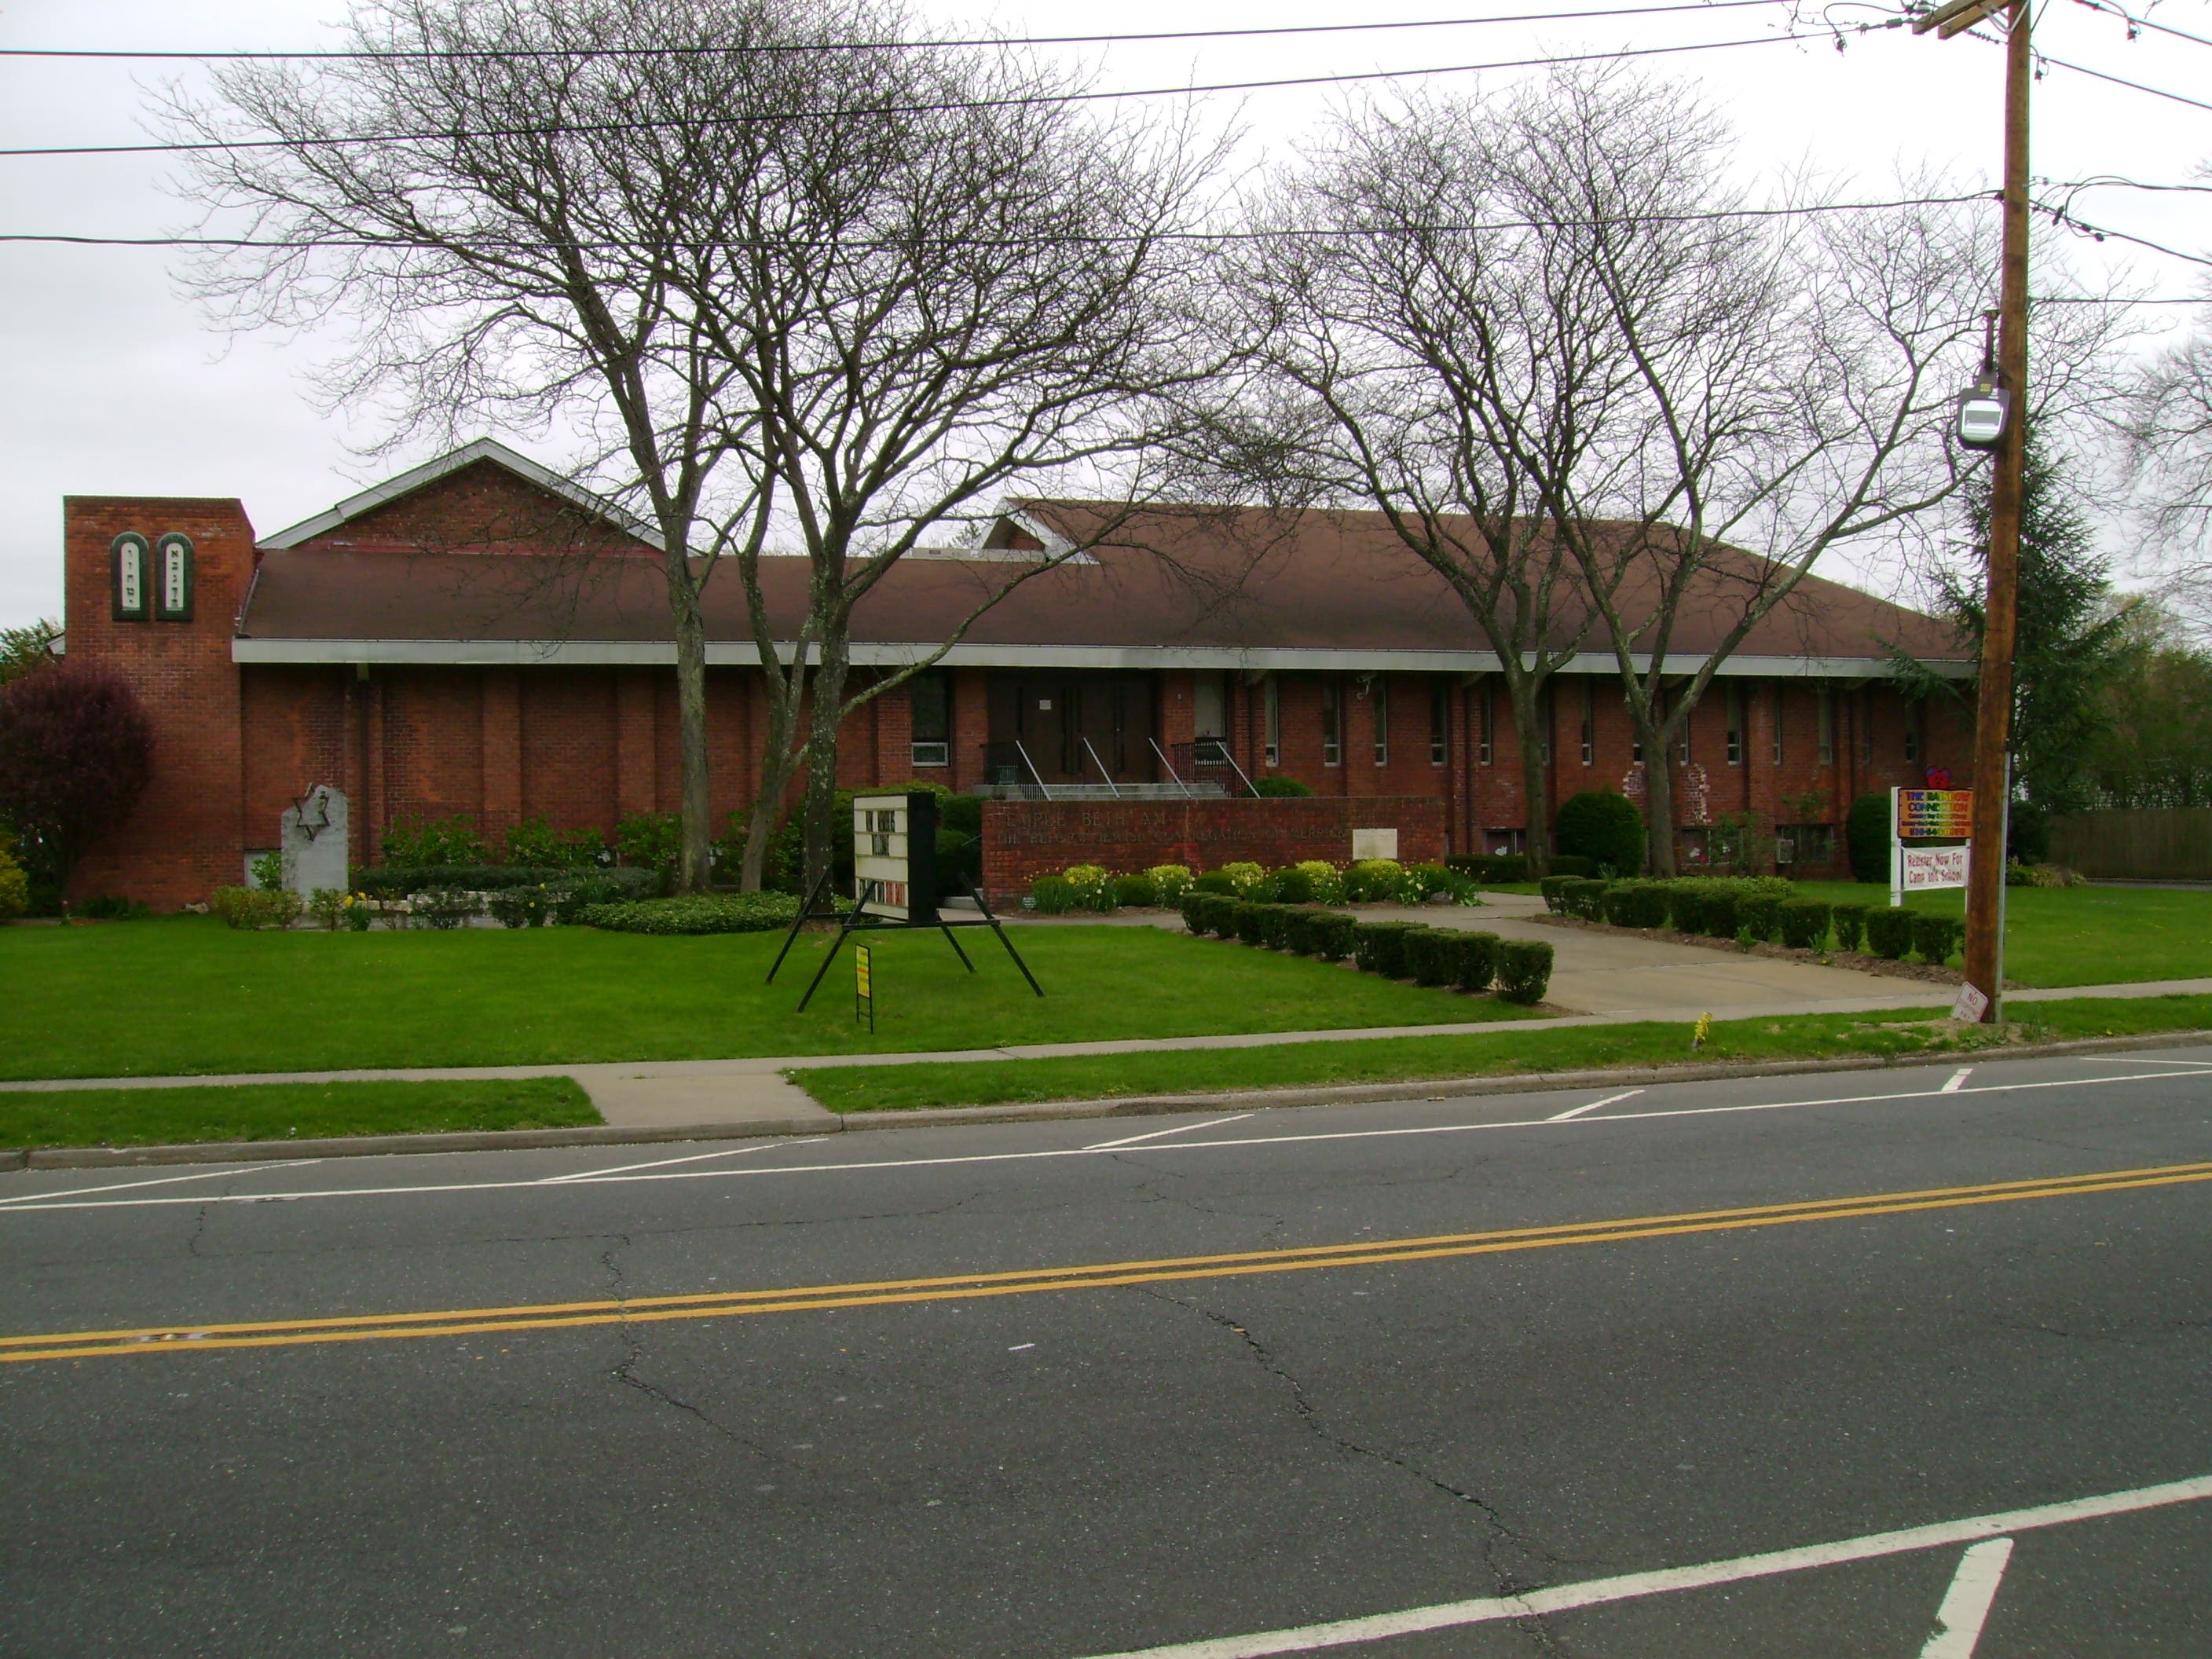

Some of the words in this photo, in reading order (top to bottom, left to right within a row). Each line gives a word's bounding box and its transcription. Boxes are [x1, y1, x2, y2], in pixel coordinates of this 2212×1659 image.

[1906, 792, 1924, 801] THE
[995, 811, 1066, 827] TEMPLE
[1082, 811, 1126, 827] BETH
[1142, 811, 1166, 826] AM
[1097, 832, 1145, 844] JEWISH
[1907, 854, 1933, 867] Register
[1935, 852, 1950, 866] Now
[1952, 852, 1963, 866] For
[1909, 870, 1925, 884] Camp
[1928, 868, 1939, 882] and
[1941, 868, 1962, 881] School
[1967, 992, 1978, 1005] NO
